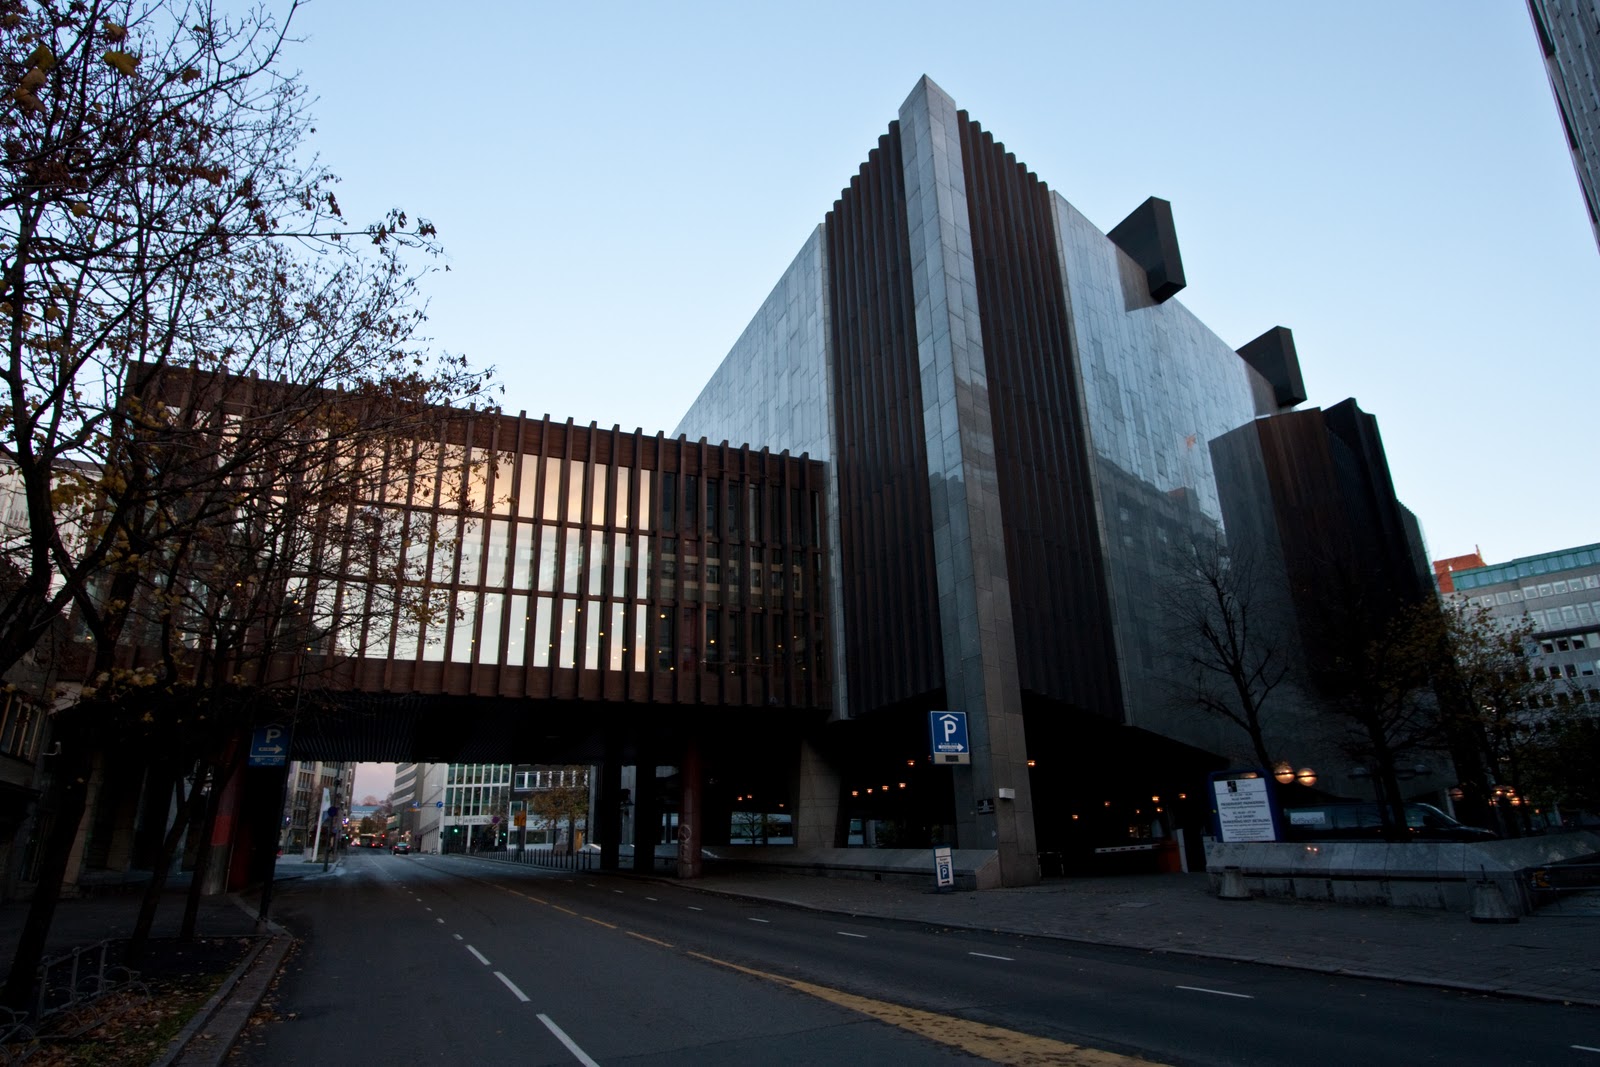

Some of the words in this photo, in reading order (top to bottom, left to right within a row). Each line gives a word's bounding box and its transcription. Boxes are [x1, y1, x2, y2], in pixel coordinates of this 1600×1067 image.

[265, 728, 282, 744] P
[943, 720, 957, 742] P
[941, 867, 948, 879] P
